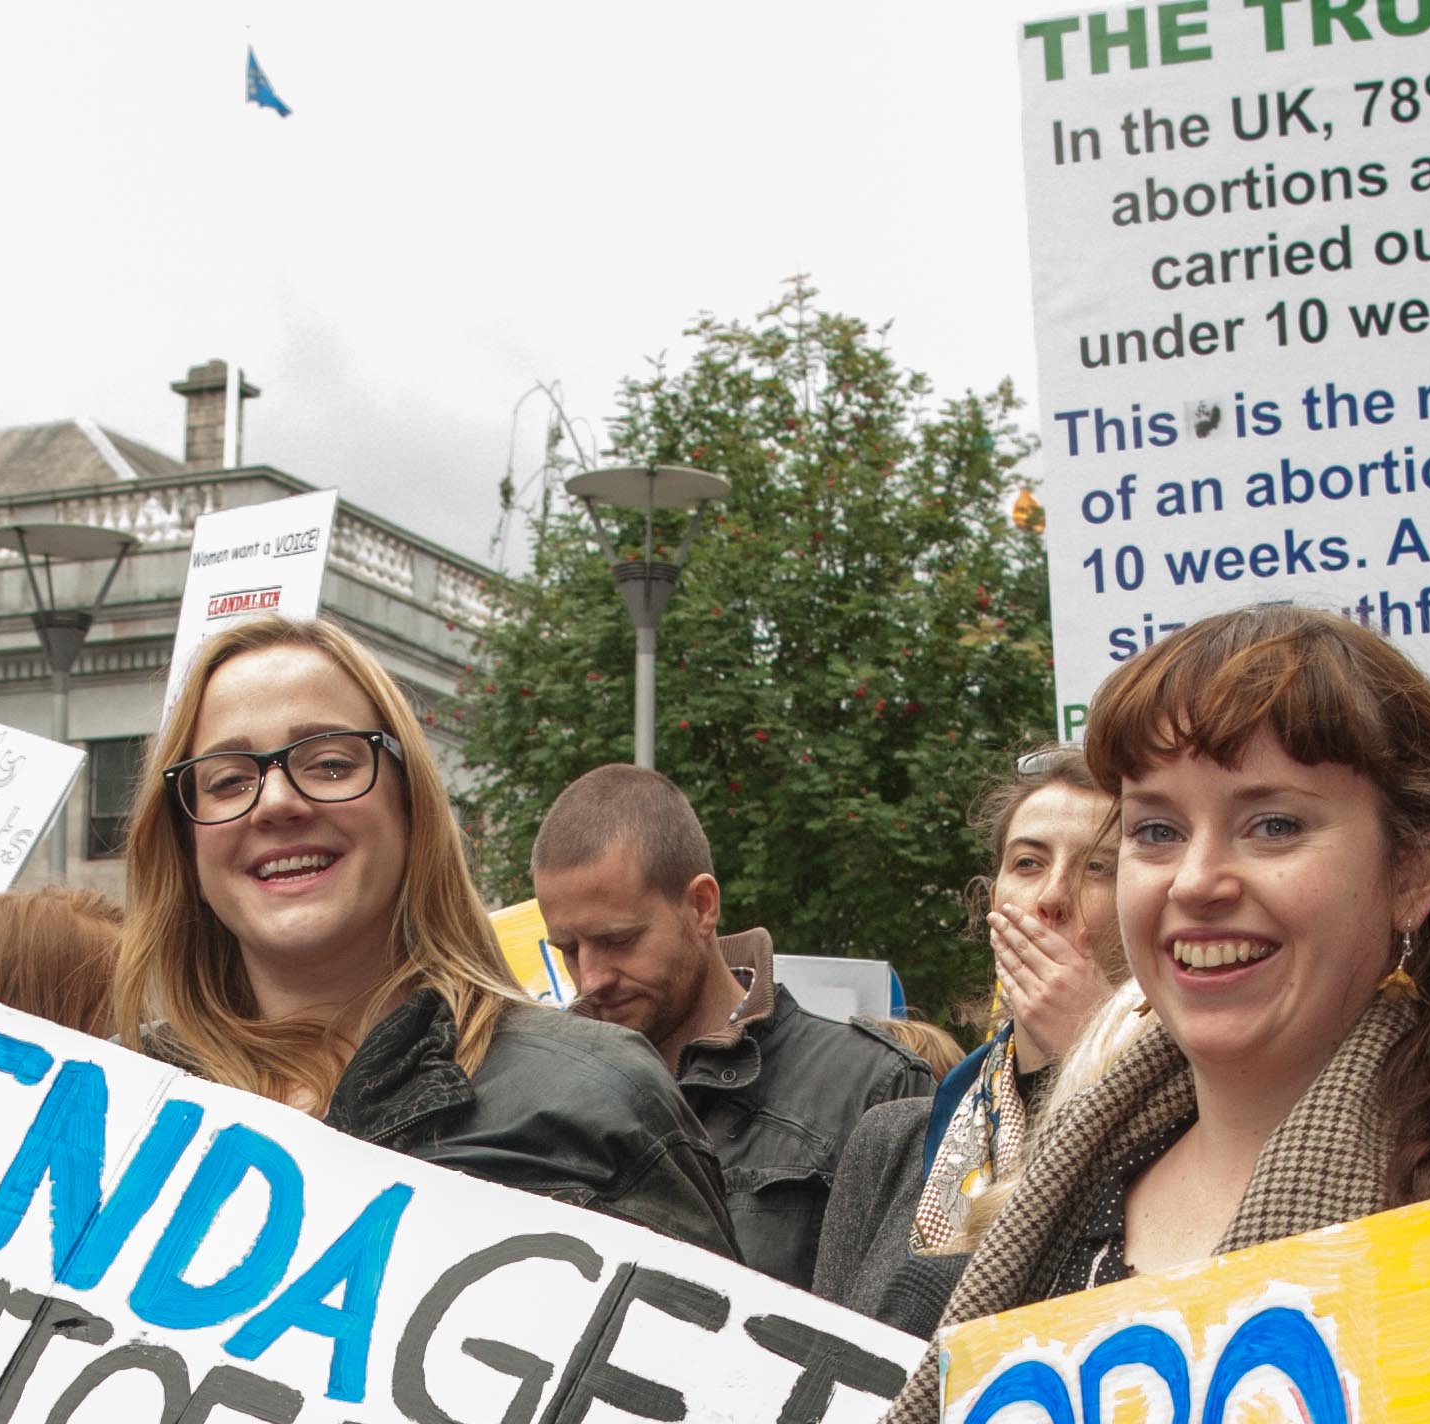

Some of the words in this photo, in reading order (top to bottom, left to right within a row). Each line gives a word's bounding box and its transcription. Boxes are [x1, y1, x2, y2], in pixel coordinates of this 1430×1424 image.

[1023, 0, 1213, 82] THE
[1052, 119, 1102, 166] In
[1121, 107, 1211, 157] the
[1231, 87, 1336, 142] UK,
[1111, 161, 1389, 228] abortions
[1150, 225, 1353, 291] carried
[1078, 313, 1244, 369] under
[1263, 298, 1330, 348] 10
[1054, 409, 1179, 457] This
[1233, 392, 1284, 440] is
[1302, 381, 1396, 433] the
[1080, 474, 1136, 525] of
[1155, 474, 1225, 519] an
[192, 548, 231, 568] Women
[230, 542, 260, 560] want
[262, 543, 271, 555] a
[1082, 543, 1146, 596] 10
[1164, 527, 1368, 588] weeks.
